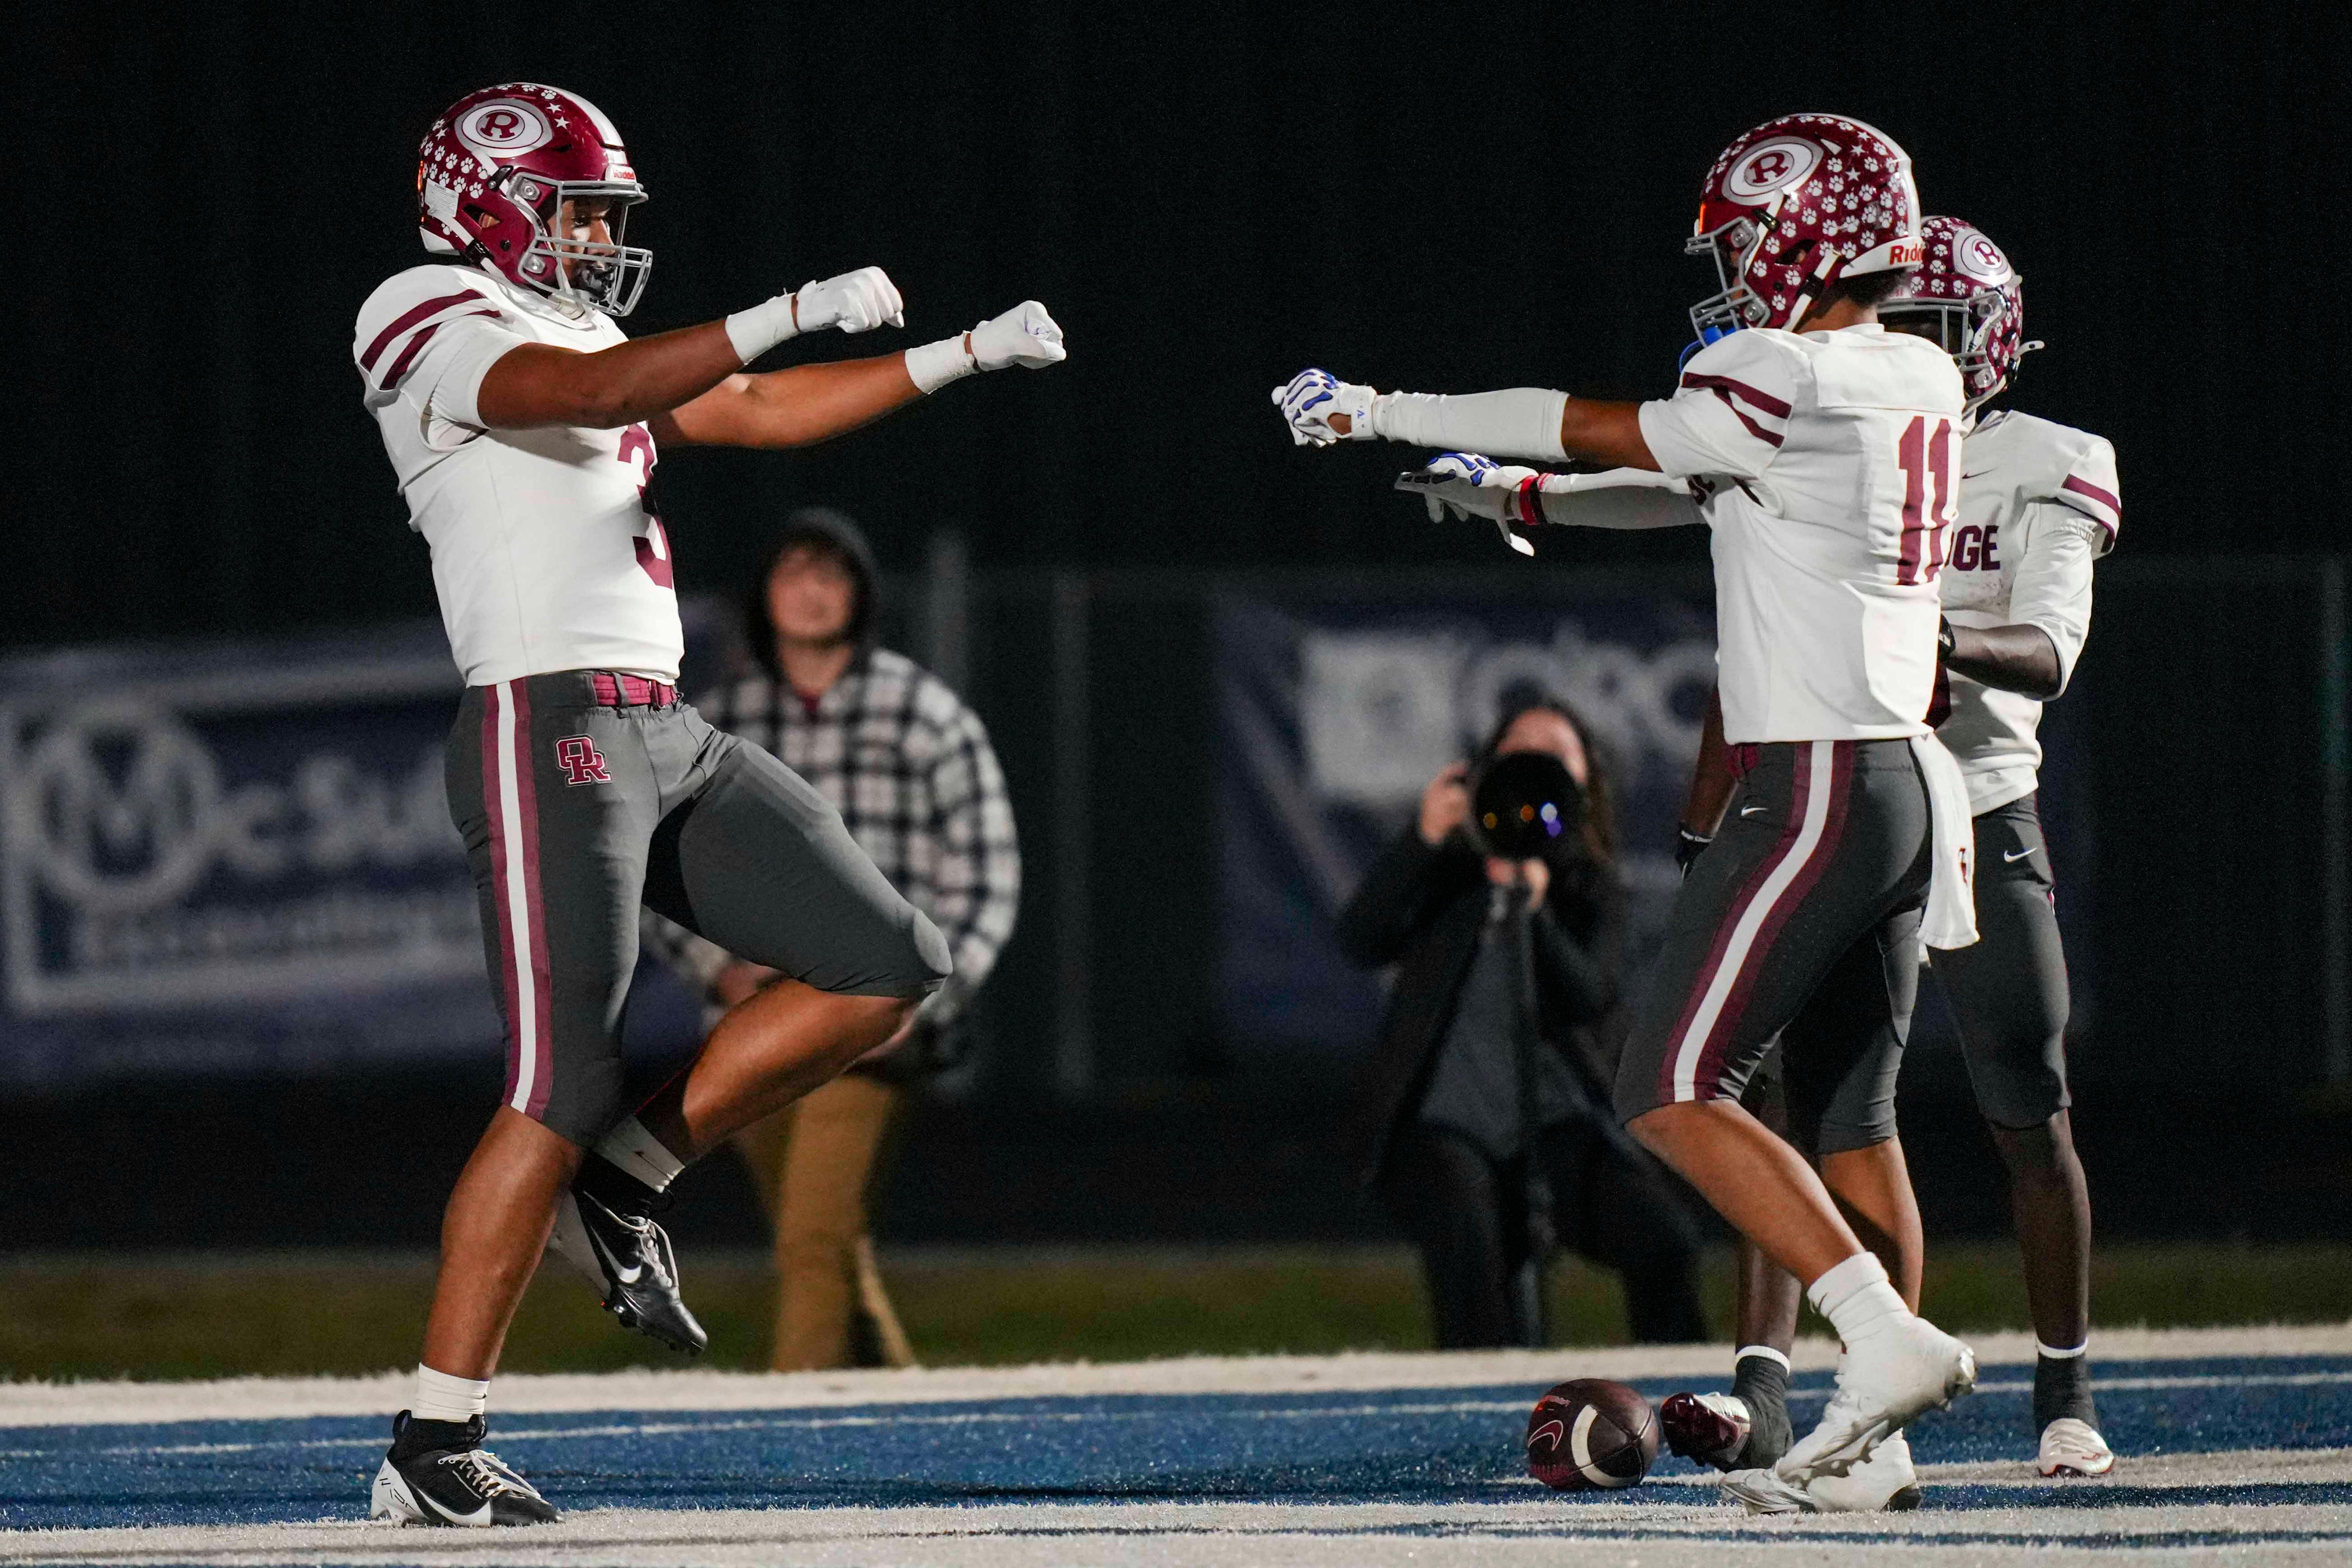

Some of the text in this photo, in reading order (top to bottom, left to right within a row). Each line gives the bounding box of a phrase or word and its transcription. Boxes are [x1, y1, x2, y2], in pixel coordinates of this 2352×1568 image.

[1752, 152, 1789, 183] R
[1975, 242, 2001, 265] R
[1898, 415, 1951, 586] 11
[1944, 525, 2000, 571] GE
